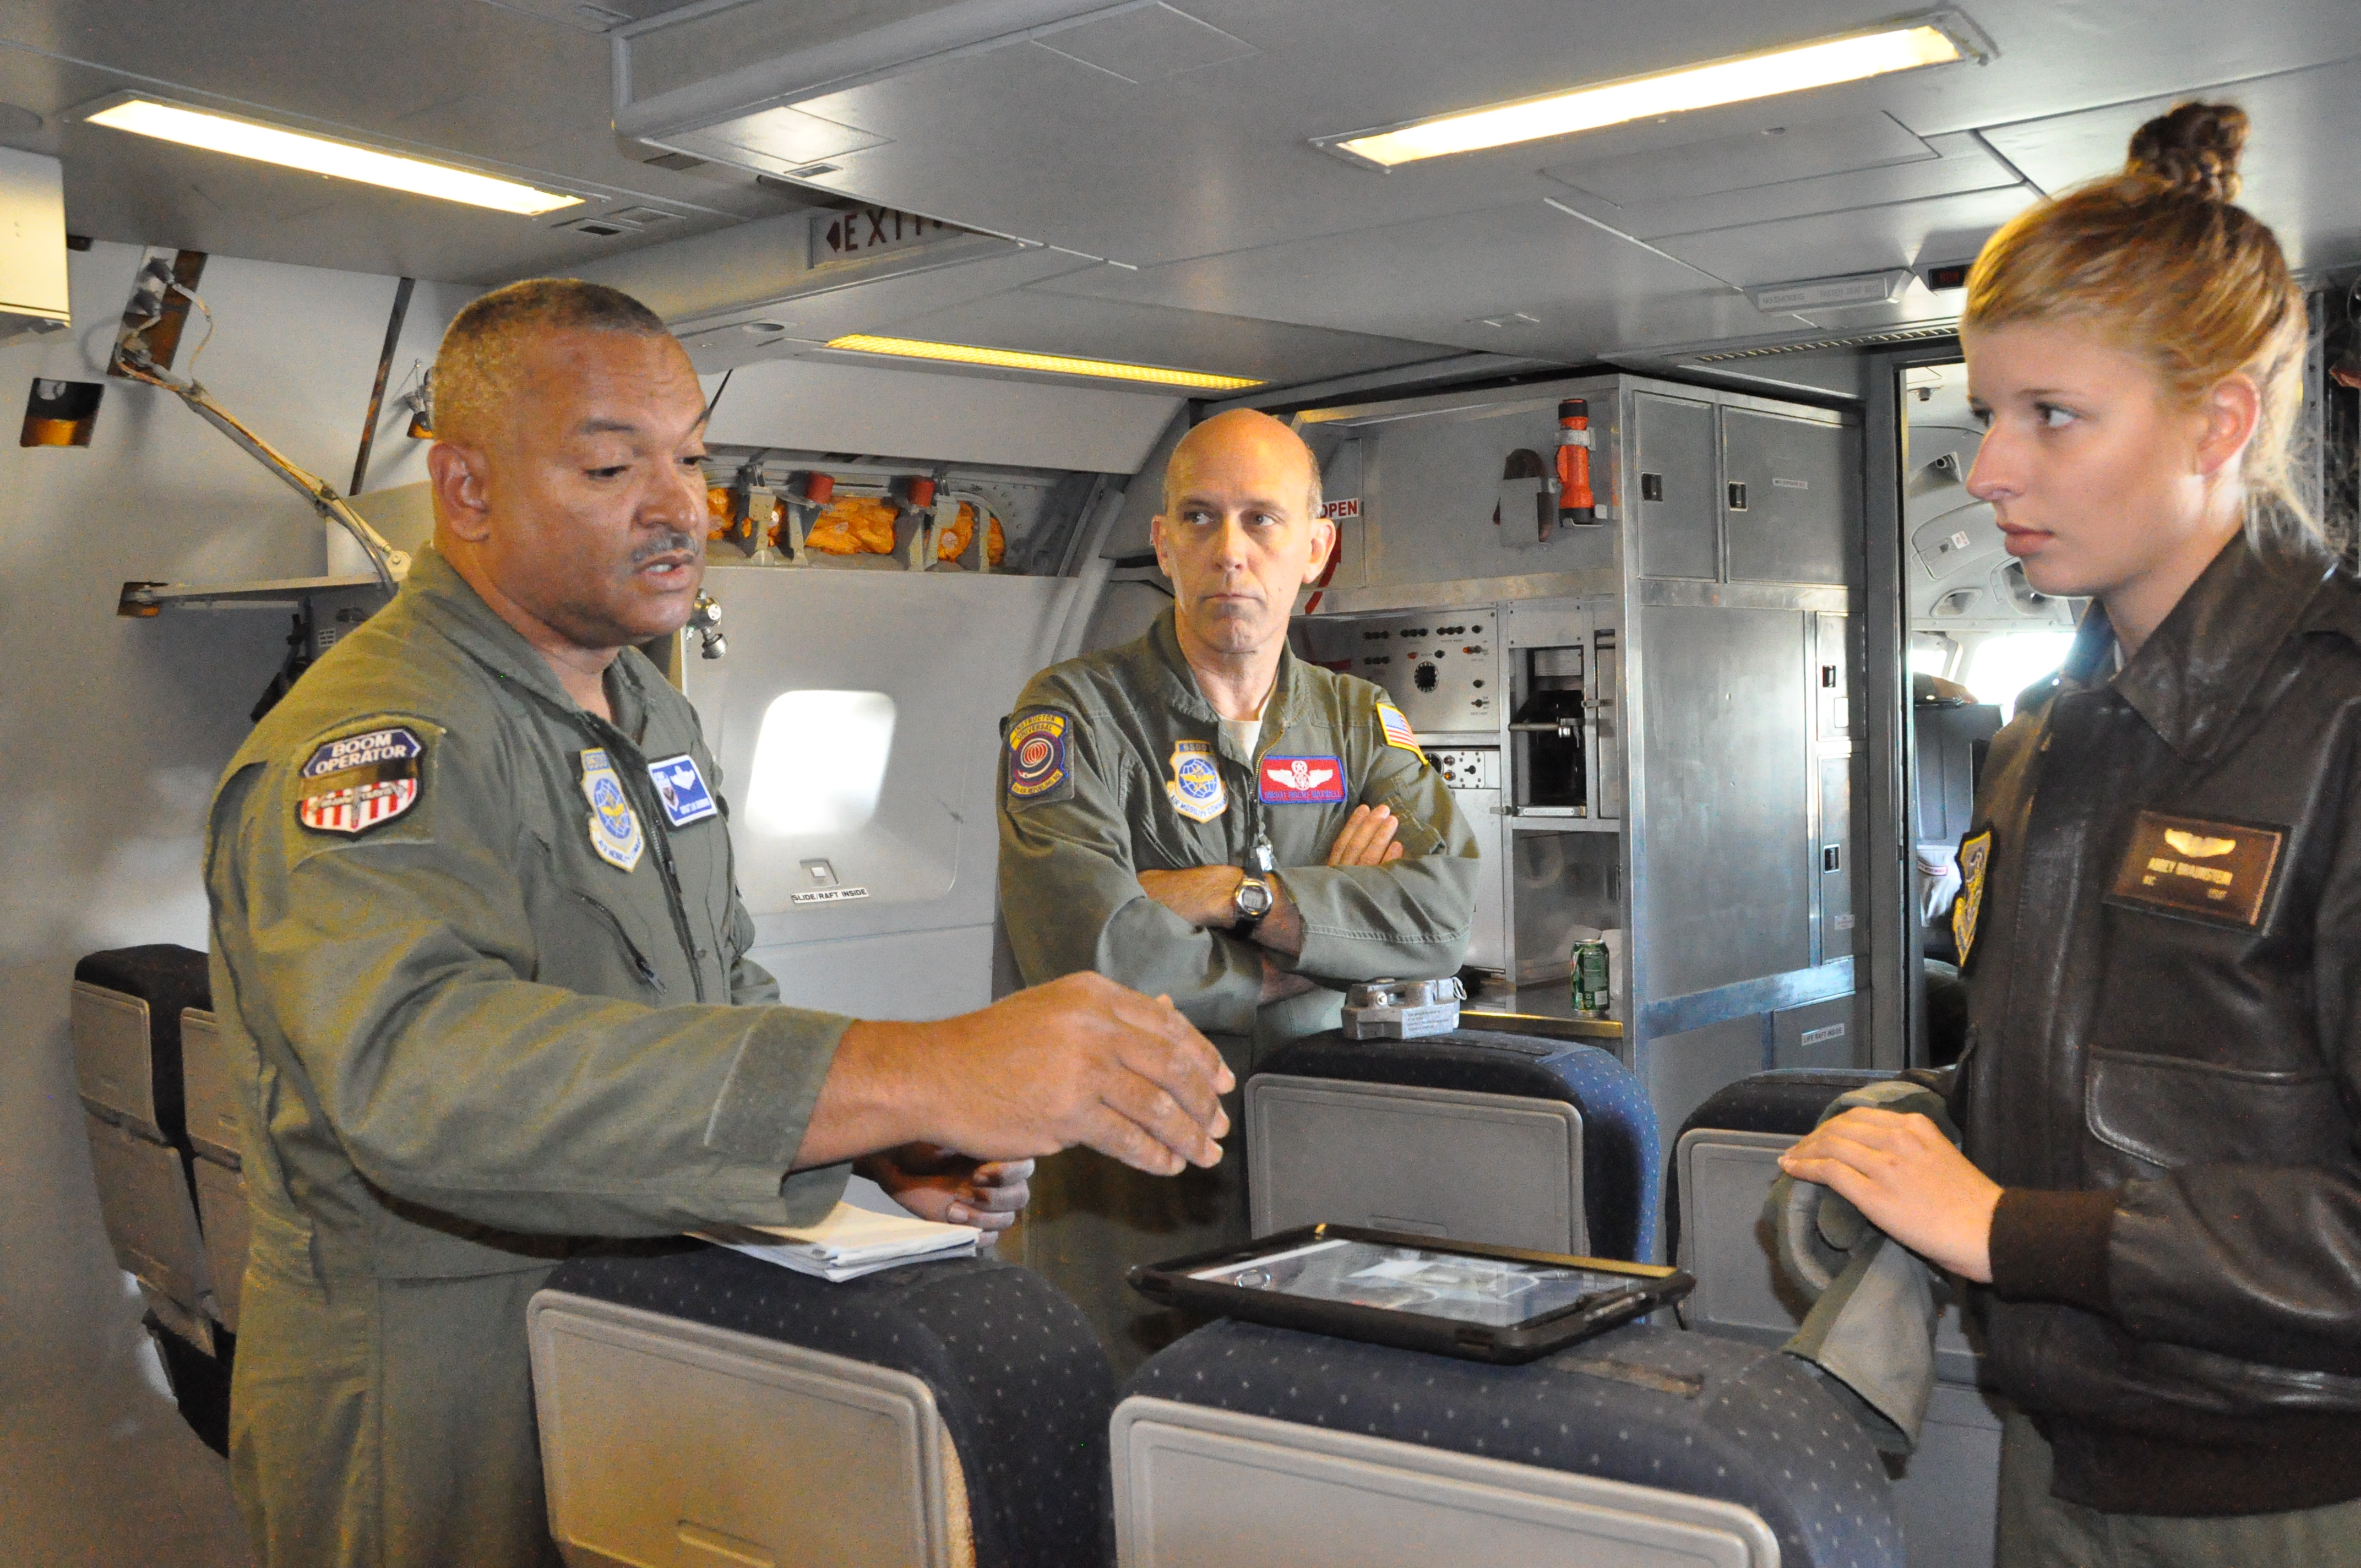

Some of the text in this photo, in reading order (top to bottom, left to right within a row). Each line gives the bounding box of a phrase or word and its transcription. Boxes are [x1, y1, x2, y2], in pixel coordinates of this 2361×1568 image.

[1321, 499, 1358, 519] OPEN
[1016, 714, 1055, 732] INSTRUCTOR
[1018, 723, 1052, 739] UNIVERSAL
[331, 733, 392, 758] BOOM
[315, 744, 407, 774] OPERATOR
[1169, 794, 1180, 806] AIR
[1180, 802, 1206, 817] MOBILITY
[792, 889, 867, 901] SLIDE/RAFT INSIDE
